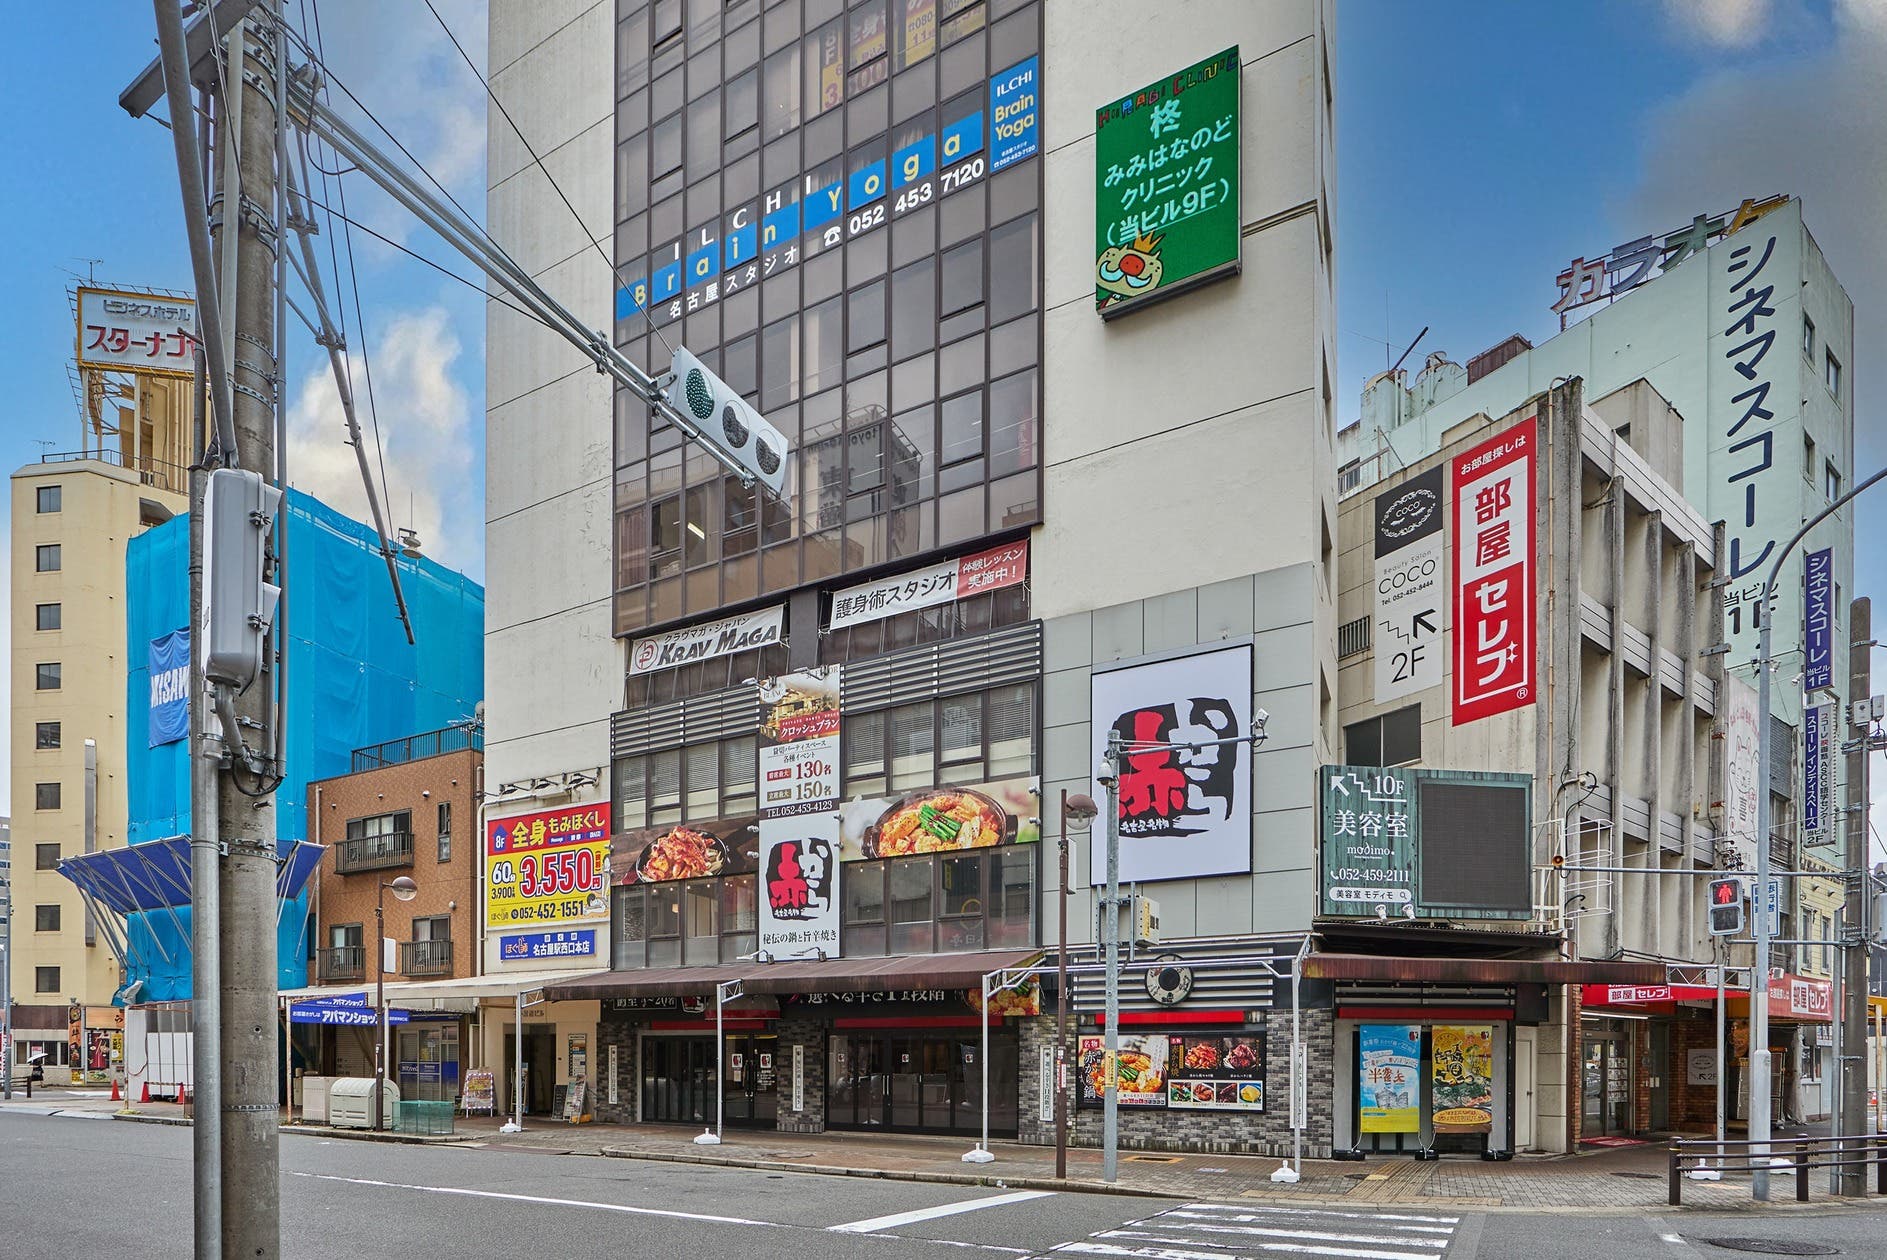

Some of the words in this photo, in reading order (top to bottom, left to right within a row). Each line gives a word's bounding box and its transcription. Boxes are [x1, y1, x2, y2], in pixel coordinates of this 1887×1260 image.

[996, 69, 1033, 98] ILCHI
[994, 93, 1034, 123] Brain
[1149, 98, 1183, 140] 柊
[994, 113, 1035, 142] Yoga
[1103, 114, 1234, 188] みみはなのど
[1120, 156, 1214, 211] クリニック
[634, 222, 777, 307] Brain
[828, 132, 961, 212] Yoga
[674, 175, 812, 261] ILCHI
[669, 245, 798, 319] 名古屋スタジオ
[849, 205, 886, 236] 052
[895, 182, 933, 213] 453
[940, 158, 985, 193] 7120
[103, 299, 192, 322] ビジネスホテル
[1725, 235, 1777, 580] シネマスコーレ
[1459, 434, 1527, 477] お部屋探しは
[1395, 500, 1421, 518] COCO
[961, 547, 1025, 575] 体験レッスン
[1378, 559, 1437, 595] COCO
[835, 569, 958, 620] 護身術スタジオ
[1808, 555, 1830, 666] シネマスコーレ
[657, 638, 713, 668] KRAV
[714, 624, 779, 654] MAGA
[1390, 644, 1426, 685] 2F
[1806, 664, 1832, 678] 当ビル
[1808, 674, 1828, 687] 1F
[781, 718, 840, 739] クロッシュブラン
[783, 750, 816, 764] 各種イベント
[795, 759, 832, 781] 130名
[795, 780, 832, 801] 150名
[1373, 774, 1405, 796] 10F
[781, 800, 834, 816] 052-453-4123
[511, 818, 548, 849] 全身
[548, 810, 606, 834] もみほぐし
[1332, 809, 1409, 838] 美容室
[495, 835, 505, 849] 8F
[1807, 834, 1825, 845] 2F
[1338, 868, 1410, 883] 052-459-2111
[1335, 889, 1362, 899] 美容室
[1363, 890, 1394, 900] モディモ
[519, 899, 585, 919] 052-452-1551
[532, 940, 591, 957] 名古屋駅西口本店
[321, 1009, 378, 1025] アパマンショッ
